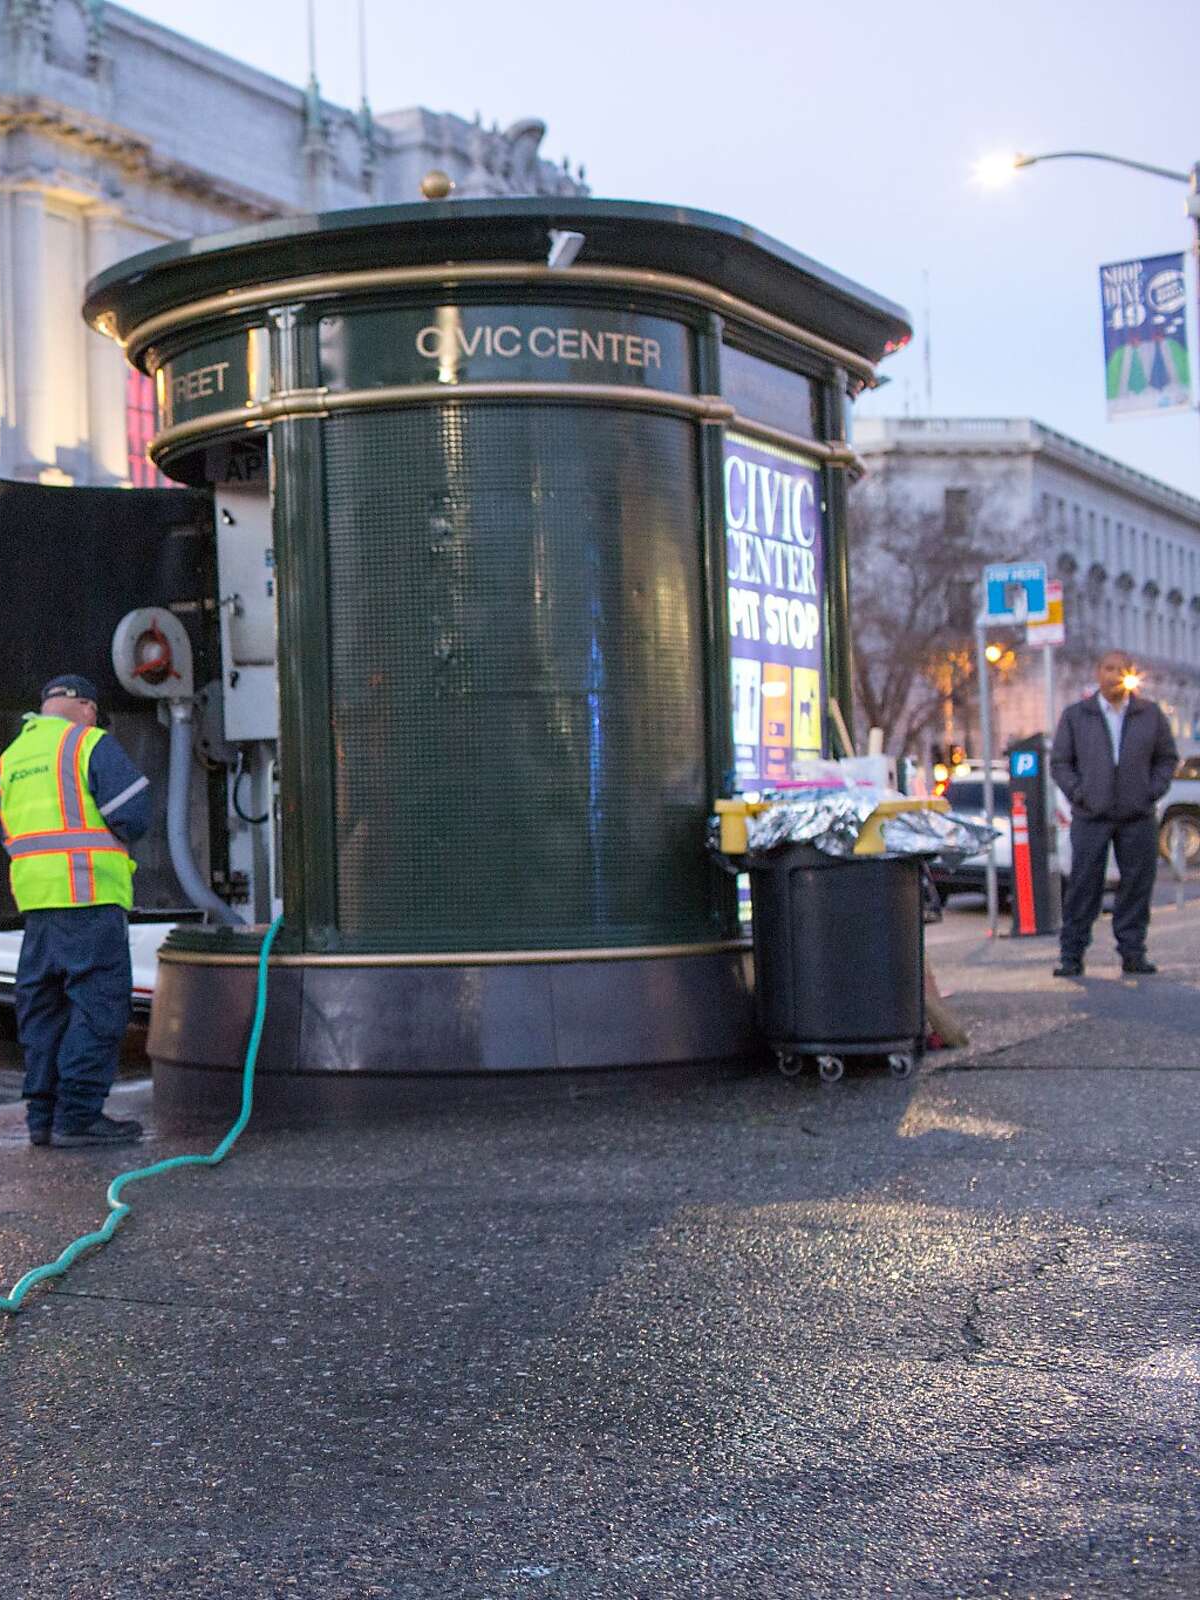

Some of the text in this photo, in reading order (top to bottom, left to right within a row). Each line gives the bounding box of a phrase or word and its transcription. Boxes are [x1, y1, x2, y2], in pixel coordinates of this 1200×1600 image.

[416, 325, 661, 369] CVIC CENTER
[724, 455, 815, 548] CIVIC
[726, 528, 816, 596] CENTER
[728, 587, 819, 650] PIT STOP
[1017, 753, 1034, 775] P
